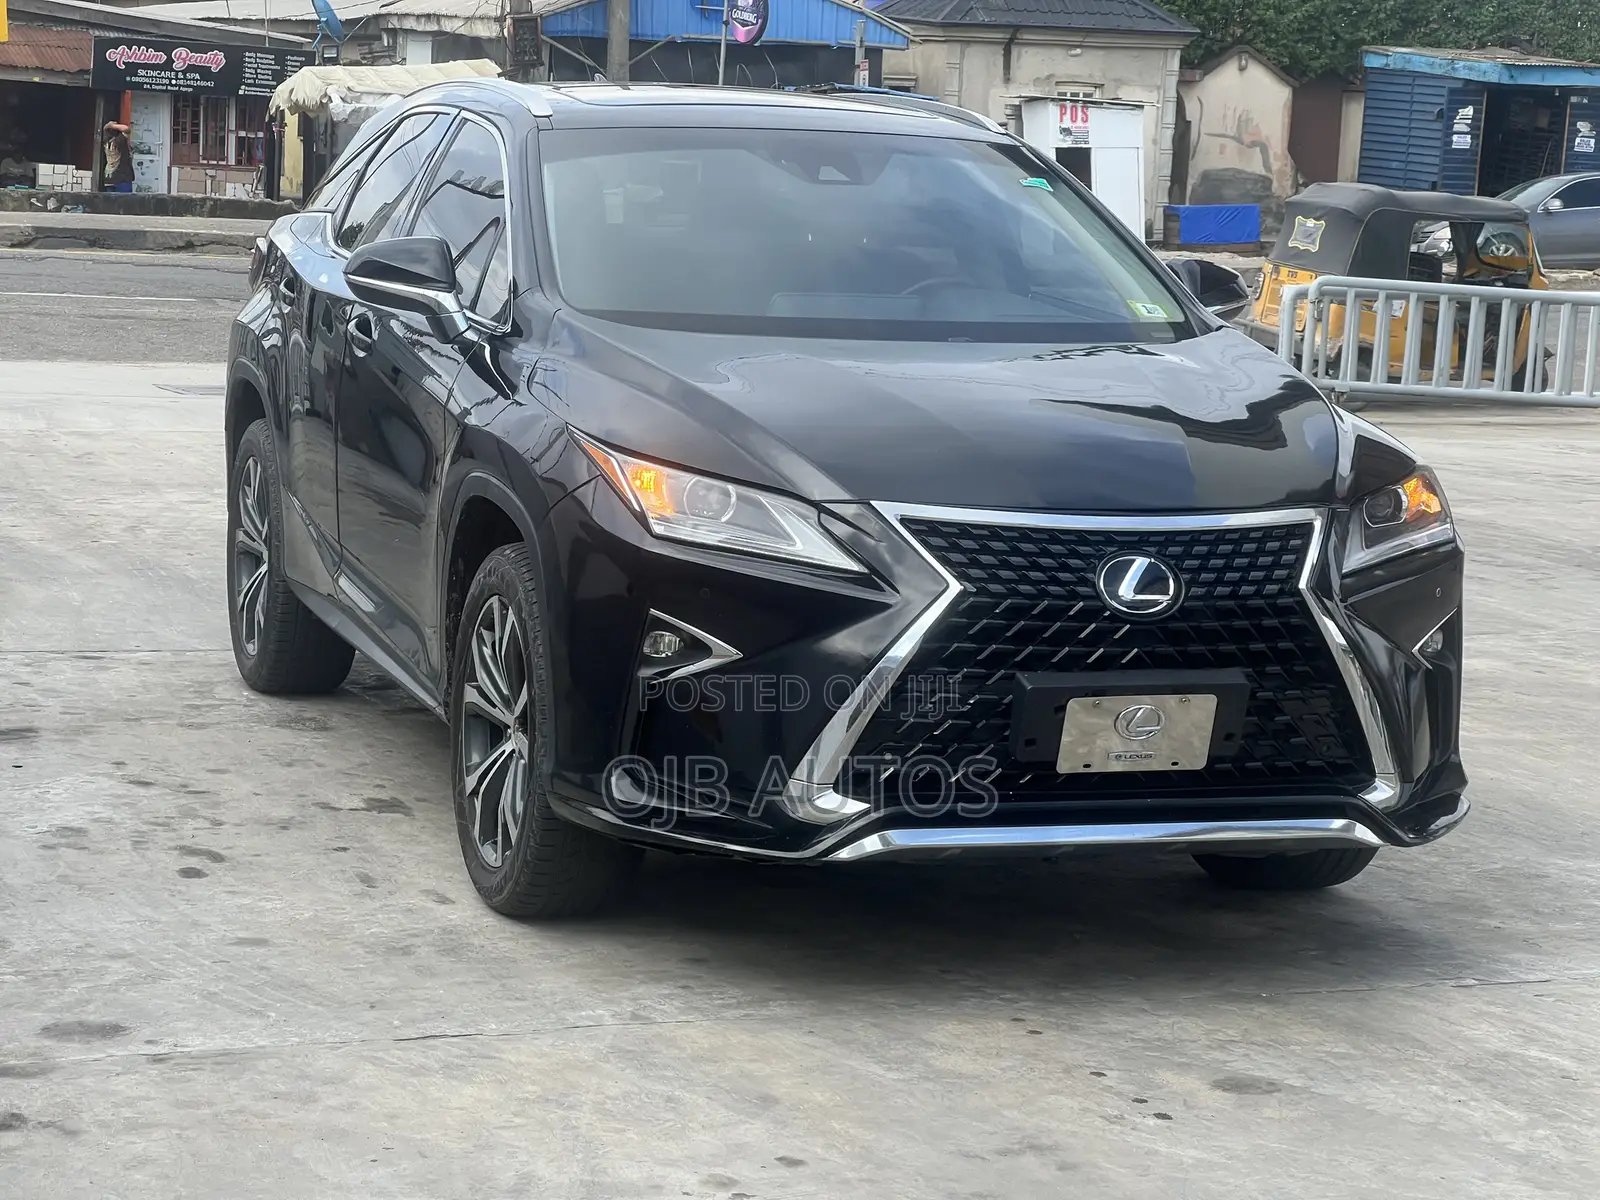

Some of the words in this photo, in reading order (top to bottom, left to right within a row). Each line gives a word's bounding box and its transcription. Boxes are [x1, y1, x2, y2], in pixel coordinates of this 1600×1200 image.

[732, 9, 757, 24] GOLDBERG
[106, 45, 167, 69] Ashbim
[172, 47, 226, 72] Beauty
[137, 69, 176, 79] SKINCARE
[1059, 103, 1089, 123] POS
